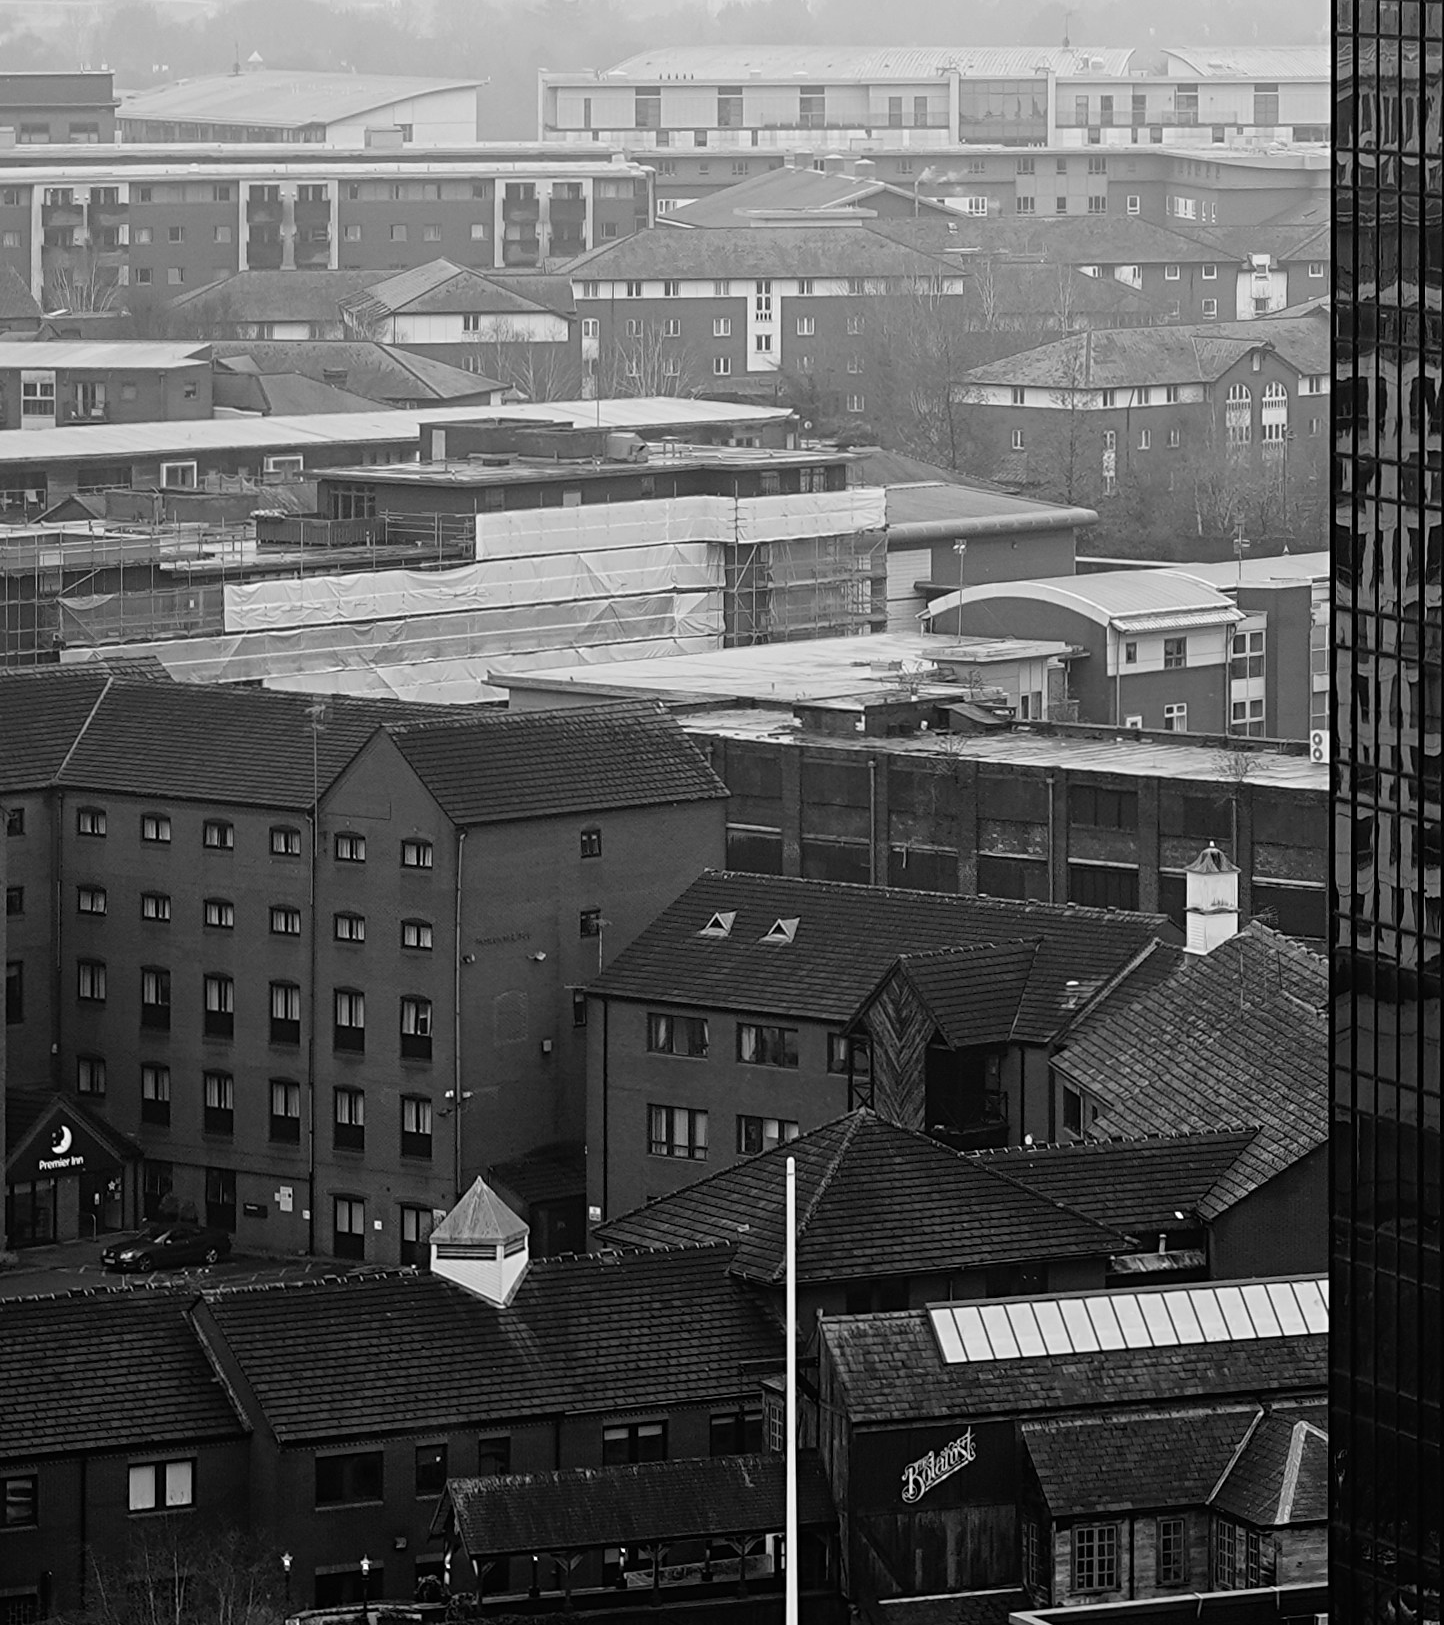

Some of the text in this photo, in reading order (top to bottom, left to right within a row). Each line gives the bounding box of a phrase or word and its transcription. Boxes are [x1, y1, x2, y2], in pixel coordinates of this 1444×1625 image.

[39, 1156, 85, 1171] Premier Inn
[901, 1425, 977, 1503] Botanist
